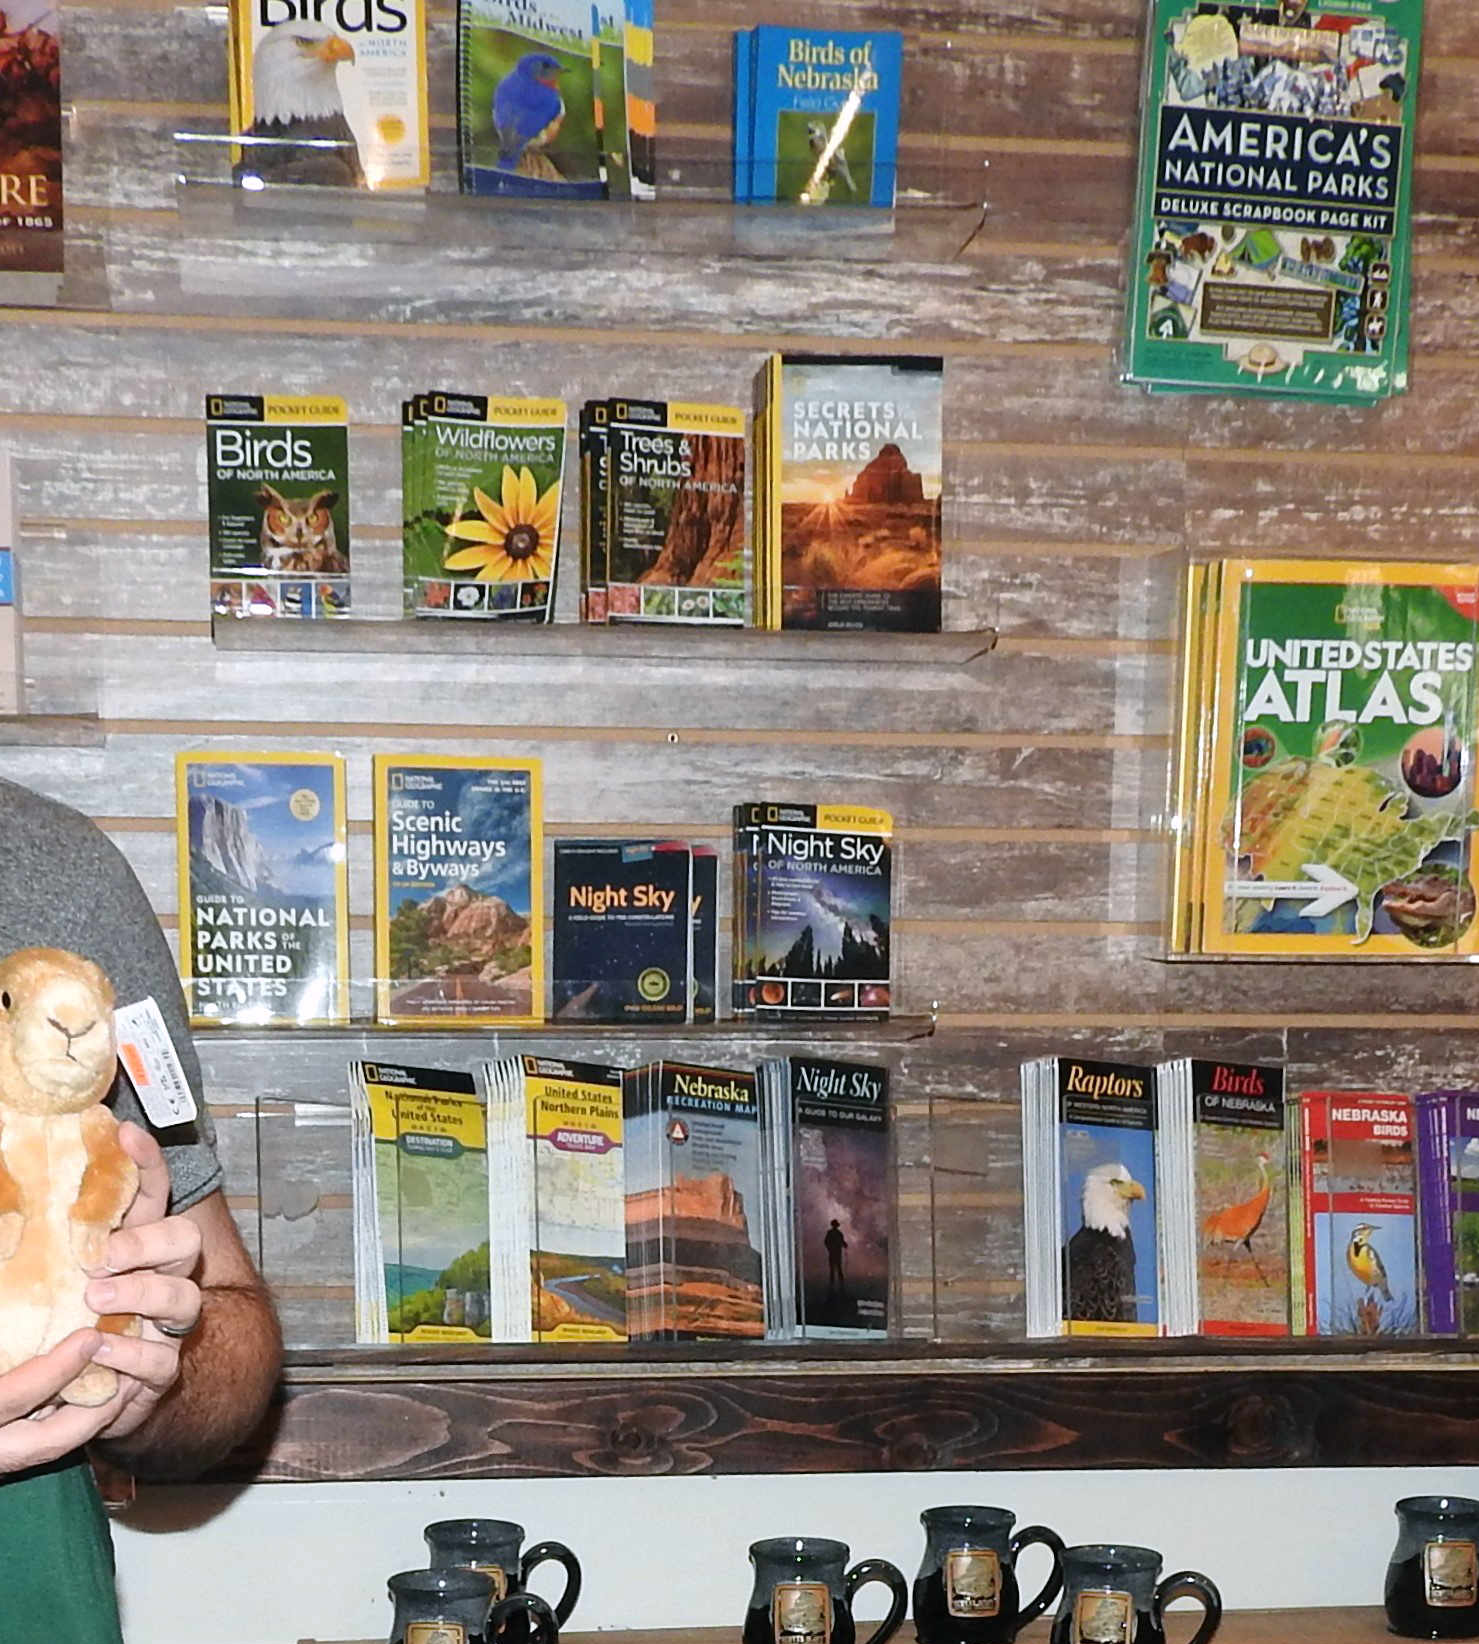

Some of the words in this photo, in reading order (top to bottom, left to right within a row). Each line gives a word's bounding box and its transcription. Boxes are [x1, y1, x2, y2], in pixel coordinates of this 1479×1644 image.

[507, 11, 585, 41] Midwest
[789, 39, 845, 65] Birds
[849, 41, 873, 65] of
[777, 64, 880, 91] Nebraska
[1167, 113, 1393, 171] AMERICA'S
[1164, 158, 1299, 194] NATIONAL
[1306, 170, 1390, 201] PARKS
[1160, 197, 1220, 216] DELUXE
[1222, 199, 1316, 225] SCRAPBOOK
[1320, 211, 1360, 229] PAGE
[1362, 213, 1388, 230] KIT
[793, 401, 896, 420] SECRETS
[434, 424, 557, 452] Wildflowers
[793, 420, 924, 441] NATIONAL
[214, 429, 313, 469] Birds
[619, 430, 674, 455] Trees
[677, 438, 692, 456] &
[793, 441, 872, 462] PARKS
[434, 448, 453, 460] OF
[454, 449, 493, 463] NORTH
[493, 451, 556, 465] AMERICA
[619, 452, 693, 478] Shrubs
[215, 469, 235, 482] OF
[236, 469, 279, 482] NORTH
[280, 470, 338, 482] AMERICA
[619, 475, 637, 487] OF
[637, 476, 681, 491] NORTH
[683, 480, 739, 494] AMERICA
[1245, 638, 1363, 669] UNITED
[1363, 641, 1474, 672] STATES
[1243, 669, 1444, 726] ATLAS
[421, 799, 435, 810] TO
[392, 810, 463, 834] Scenic
[392, 834, 507, 861] Highways
[767, 832, 840, 861] Night
[840, 837, 885, 865] Sky
[392, 862, 405, 876] &
[406, 858, 481, 882] Byways
[767, 860, 784, 870] OF
[786, 860, 827, 873] NORTH
[828, 863, 883, 876] AMERICA
[569, 885, 628, 914] Night
[632, 885, 676, 912] Sky
[196, 907, 331, 928] NATIONAL
[196, 930, 278, 951] PARKS
[197, 953, 293, 974] UNITED
[197, 977, 288, 998] STATES
[672, 1073, 750, 1102] Nebraska
[796, 1066, 848, 1100] Night
[849, 1072, 882, 1105] Sky
[1066, 1064, 1145, 1100] Raptors
[1212, 1065, 1266, 1096] Birds
[543, 1084, 581, 1101] United
[581, 1089, 614, 1105] States
[666, 1095, 731, 1114] RECREATION
[734, 1102, 758, 1115] MAP
[1204, 1095, 1221, 1108] OF
[1221, 1096, 1277, 1114] NEBRASKA
[391, 1107, 429, 1123] United
[430, 1111, 465, 1126] States
[540, 1099, 587, 1116] Northern
[588, 1105, 620, 1121] Plains
[1331, 1108, 1408, 1124] NEBRASKA
[555, 1130, 606, 1148] ADVENTURE
[1372, 1123, 1408, 1138] BIRDS
